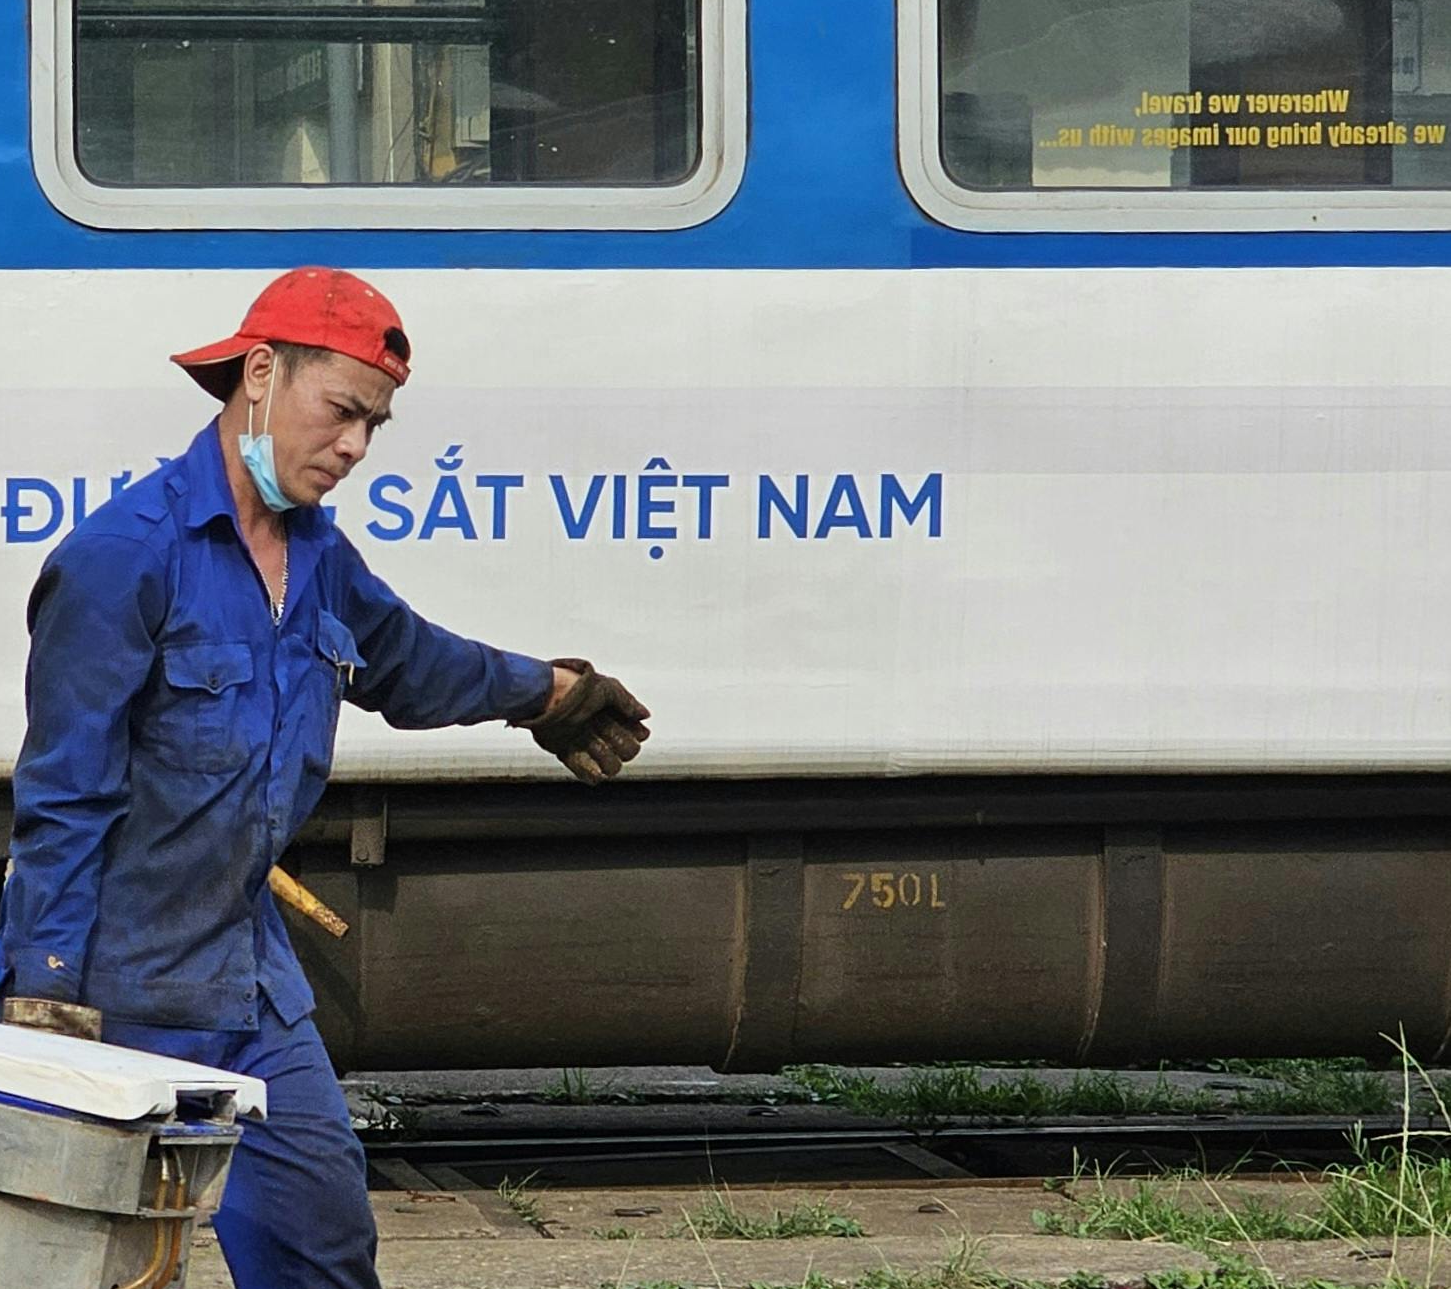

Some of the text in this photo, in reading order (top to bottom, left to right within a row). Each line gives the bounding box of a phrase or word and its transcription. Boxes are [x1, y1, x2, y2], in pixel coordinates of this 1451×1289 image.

[366, 445, 524, 542] SẮT
[549, 457, 730, 560] VIỆT
[758, 473, 943, 540] NAM
